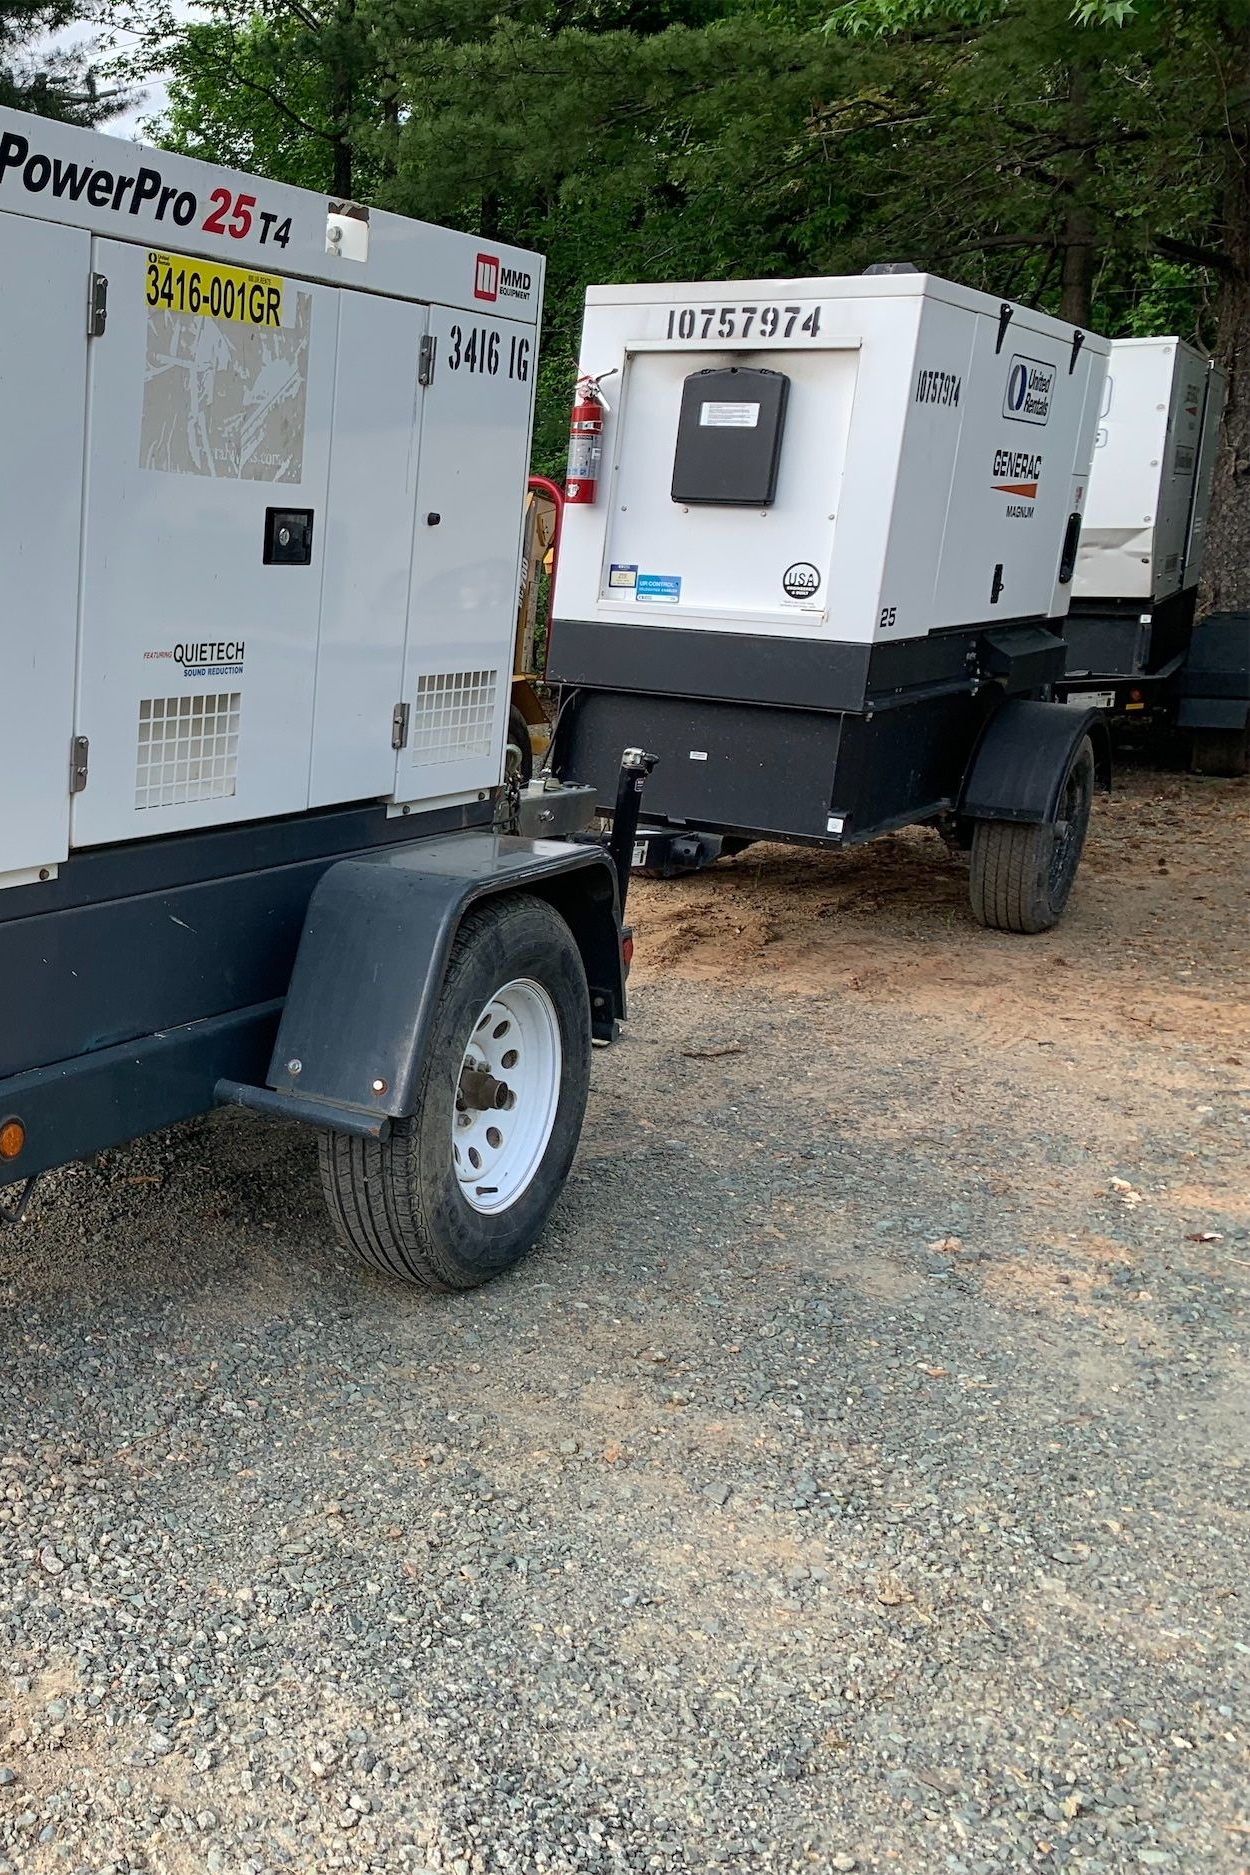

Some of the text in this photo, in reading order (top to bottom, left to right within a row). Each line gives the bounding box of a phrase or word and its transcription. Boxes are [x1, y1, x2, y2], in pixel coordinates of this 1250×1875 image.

[202, 188, 257, 239] 25
[259, 212, 292, 249] T4
[500, 268, 531, 291] MMD
[146, 264, 281, 327] 3416-001GR
[499, 287, 531, 301] EQUIPMENT
[667, 306, 822, 340] 10757974
[448, 325, 500, 376] 3416
[915, 370, 962, 408] 10757974
[1028, 368, 1053, 394] United
[1023, 392, 1049, 417] Rentals
[992, 449, 1042, 480] GENERAC
[1005, 505, 1035, 519] MAGNUM
[788, 572, 815, 587] USA
[879, 607, 897, 628] 25
[143, 641, 245, 664] FEATURING QUIETECH
[183, 665, 244, 678] SOUND REDUCTION
